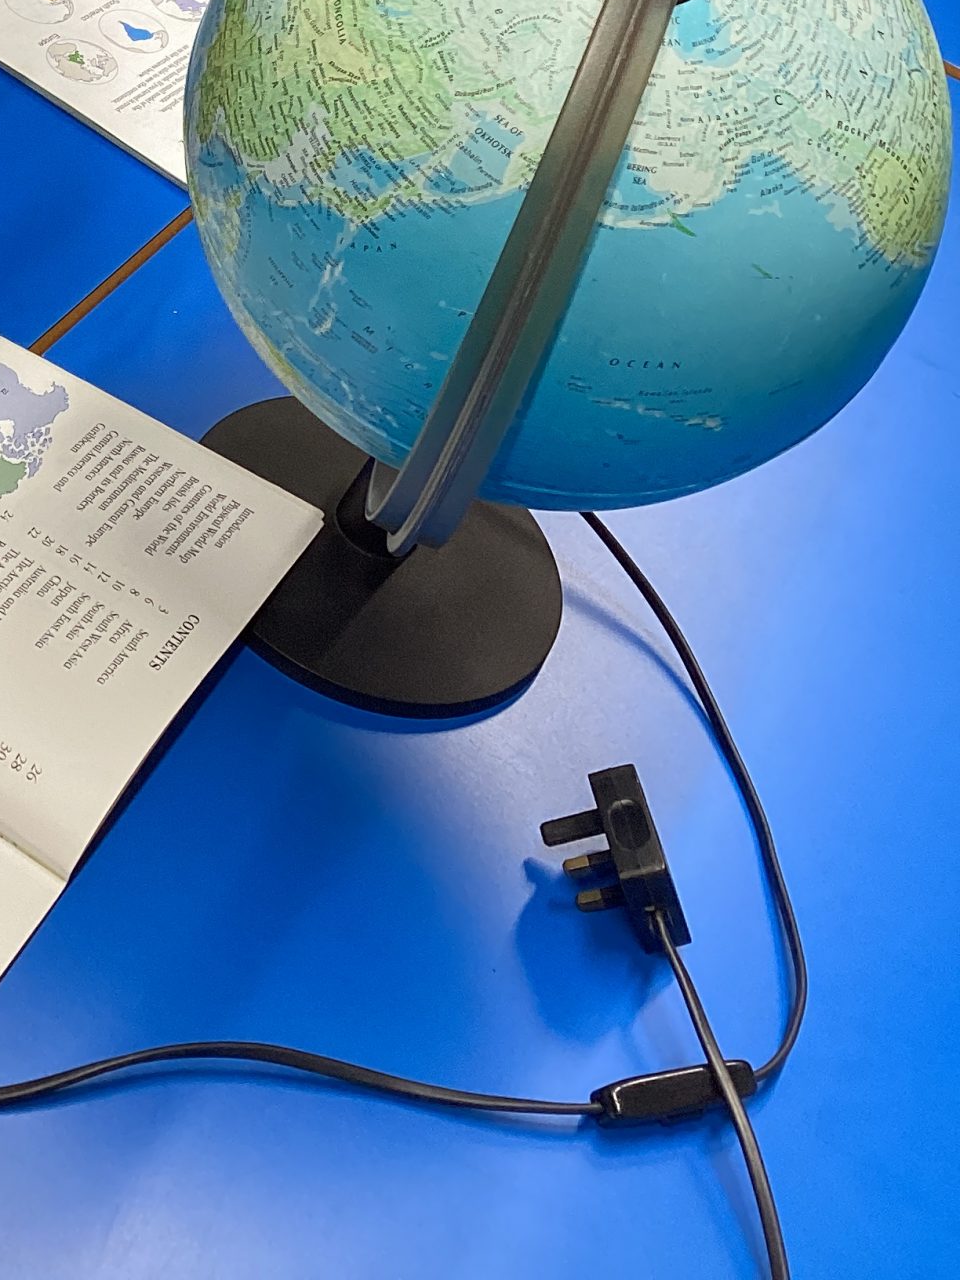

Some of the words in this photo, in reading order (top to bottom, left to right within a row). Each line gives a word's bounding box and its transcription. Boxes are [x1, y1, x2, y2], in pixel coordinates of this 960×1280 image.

[493, 113, 510, 128] SEA
[509, 124, 523, 138] OF
[454, 139, 484, 164] Sakhalin
[472, 125, 515, 159] OKHOTSK
[626, 162, 658, 174] BERING
[632, 176, 646, 186] SEA
[758, 182, 784, 197] Alaska
[609, 358, 682, 369] OCEAN
[69, 422, 105, 453] Caribbean
[91, 430, 119, 453] Central
[109, 439, 132, 455] North
[66, 449, 96, 477] America
[121, 444, 146, 465] Russia
[141, 453, 159, 466] The
[84, 453, 113, 481] America
[108, 464, 124, 479] and
[143, 461, 173, 486] Western
[52, 476, 68, 492] and
[97, 464, 147, 510] Mediterranean
[100, 476, 113, 487] its
[130, 484, 146, 501] and
[153, 468, 186, 497] Northern
[174, 475, 199, 497] British
[75, 485, 105, 511] Borders
[132, 496, 159, 520] Europe
[161, 495, 181, 512] Isles
[180, 484, 212, 514] Countries
[203, 493, 227, 513] World
[107, 498, 135, 525] Central
[172, 513, 183, 525] of
[210, 499, 240, 529] Physical
[84, 522, 113, 547] Europe
[161, 521, 177, 535] the
[164, 510, 209, 555] Environments
[193, 527, 218, 548] World
[213, 507, 254, 548] Introduction
[0, 548, 20, 562] The
[143, 534, 168, 556] World
[178, 546, 199, 563] Map
[15, 557, 34, 572] The
[11, 564, 46, 598] Australia
[35, 575, 61, 597] China
[50, 580, 77, 606] Japan
[65, 592, 90, 614] South
[49, 613, 71, 631] East
[80, 601, 105, 623] South
[94, 610, 119, 632] South
[34, 628, 54, 648] Asia
[65, 621, 85, 640] Asia
[108, 619, 133, 643] Africa
[123, 628, 149, 651] South
[78, 633, 102, 652] West
[148, 614, 199, 670] CONTENTS
[62, 649, 83, 669] Asia
[96, 649, 129, 684] America
[10, 752, 27, 772] 28
[25, 763, 42, 783] 26
